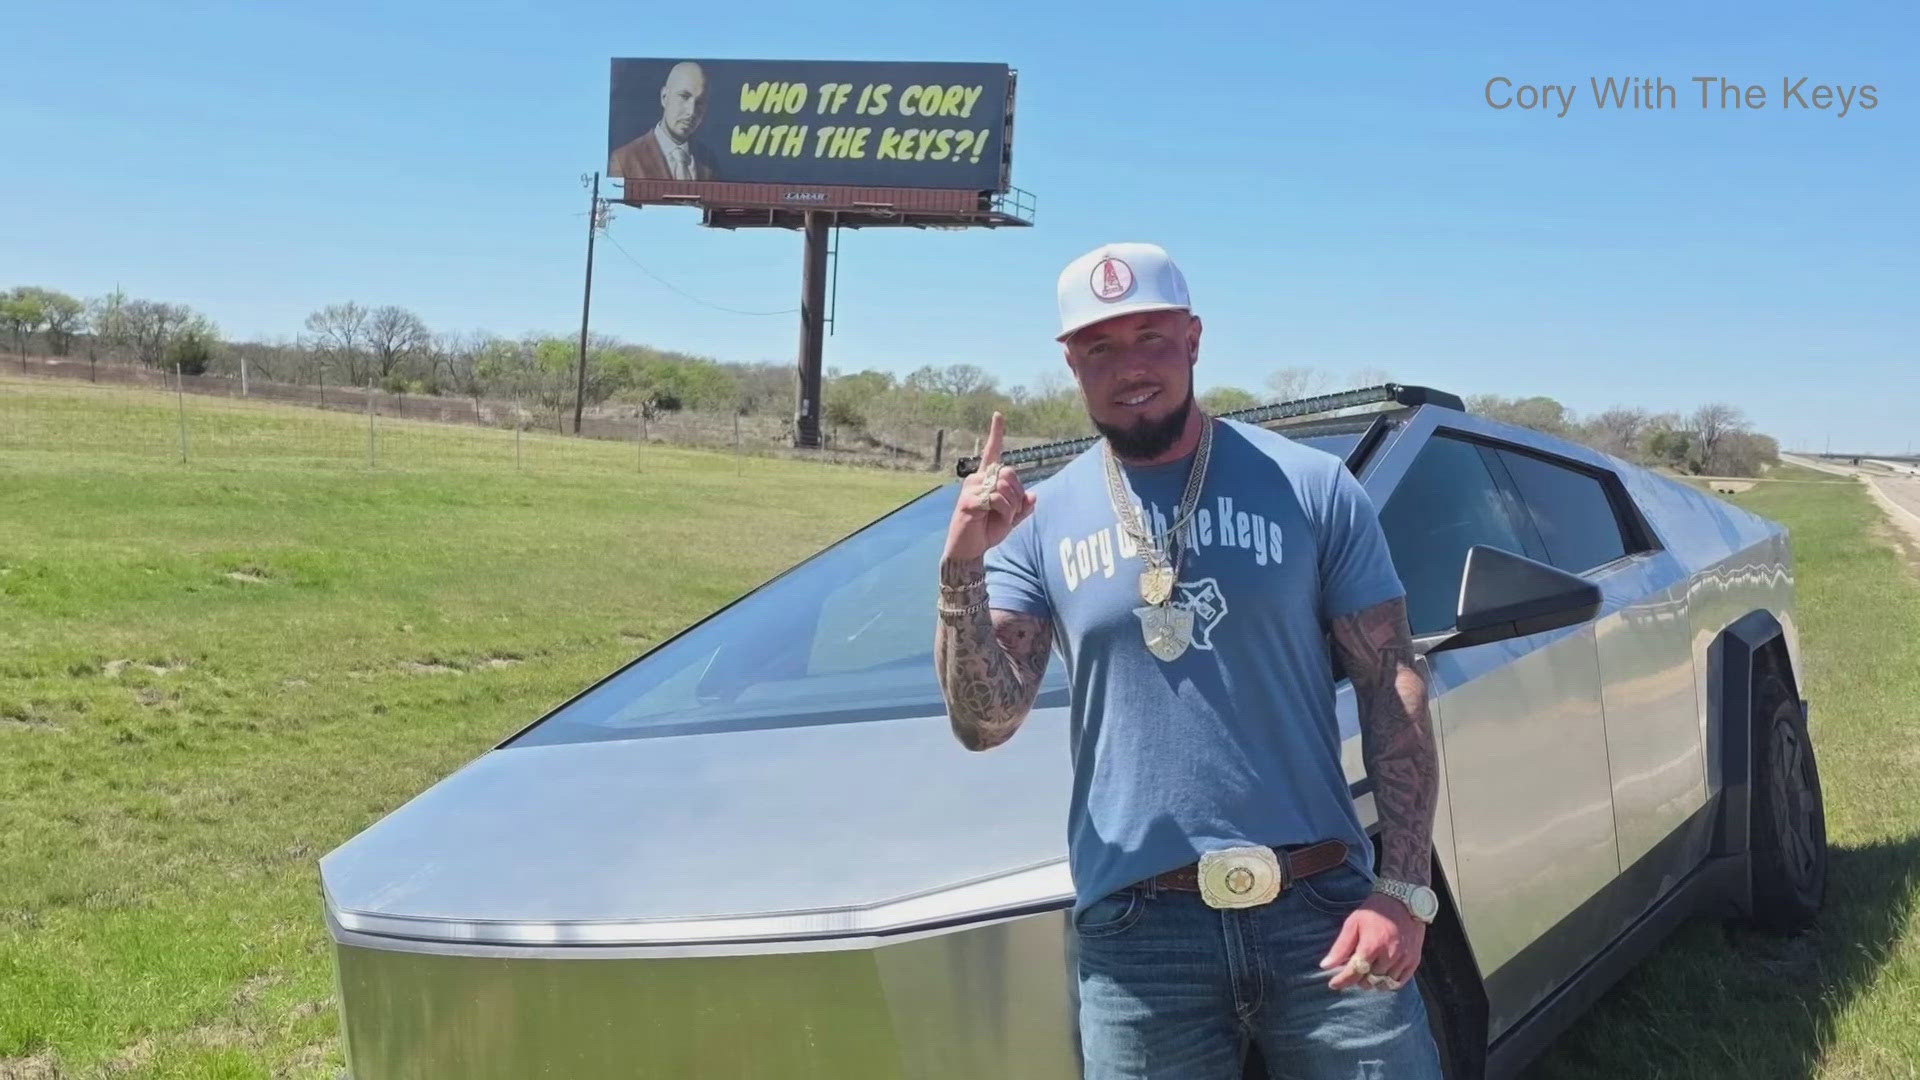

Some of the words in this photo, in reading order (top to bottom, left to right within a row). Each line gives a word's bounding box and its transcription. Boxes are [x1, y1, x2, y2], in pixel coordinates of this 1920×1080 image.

[740, 81, 808, 115] WHO
[816, 83, 852, 115] TF
[856, 83, 893, 115] IS
[899, 84, 983, 118] CORY
[730, 124, 809, 159] WITH
[814, 126, 872, 160] THE
[876, 127, 990, 164] KEYS?!
[1059, 527, 1115, 593] Cory
[1217, 496, 1283, 567] Keys
